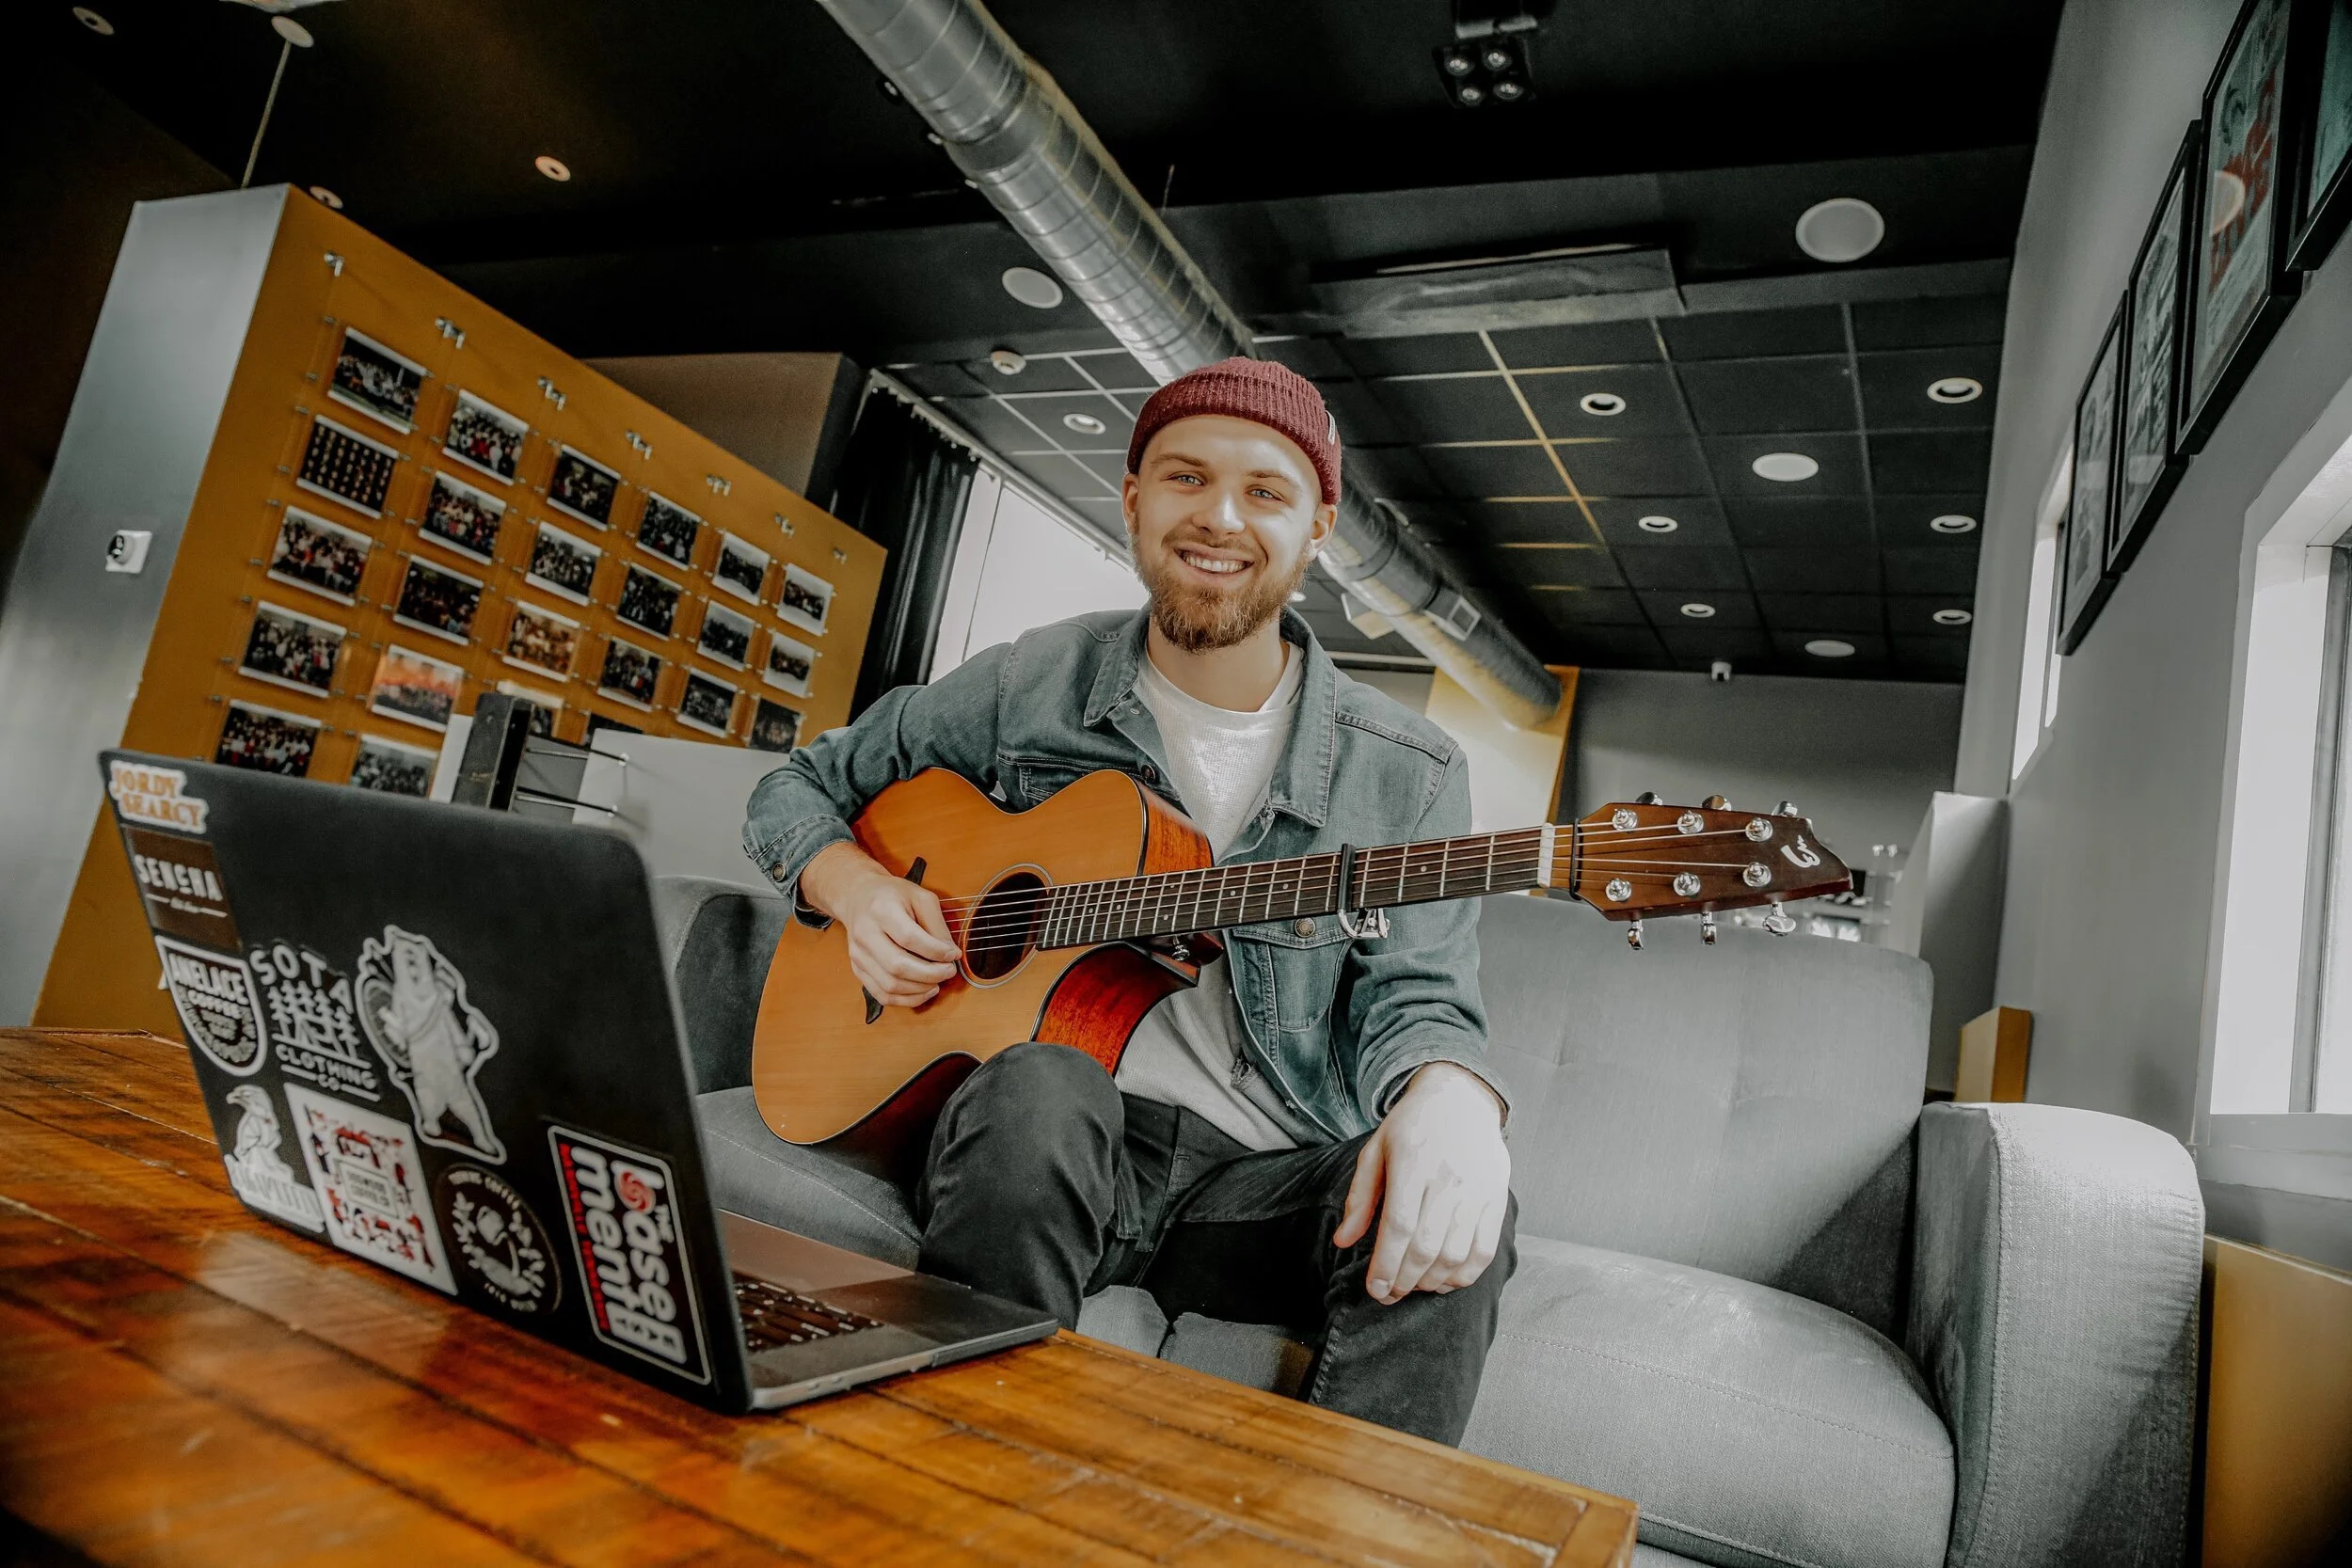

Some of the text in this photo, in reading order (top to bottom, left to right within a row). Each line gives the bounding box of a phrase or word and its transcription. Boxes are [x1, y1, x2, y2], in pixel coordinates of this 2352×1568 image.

[110, 768, 179, 799] JORDY
[121, 793, 200, 827] SEARCY
[134, 854, 224, 902] SENCHA
[249, 944, 354, 1015] SOTA
[276, 1044, 376, 1089] CLOTHING
[317, 1073, 340, 1091] CO
